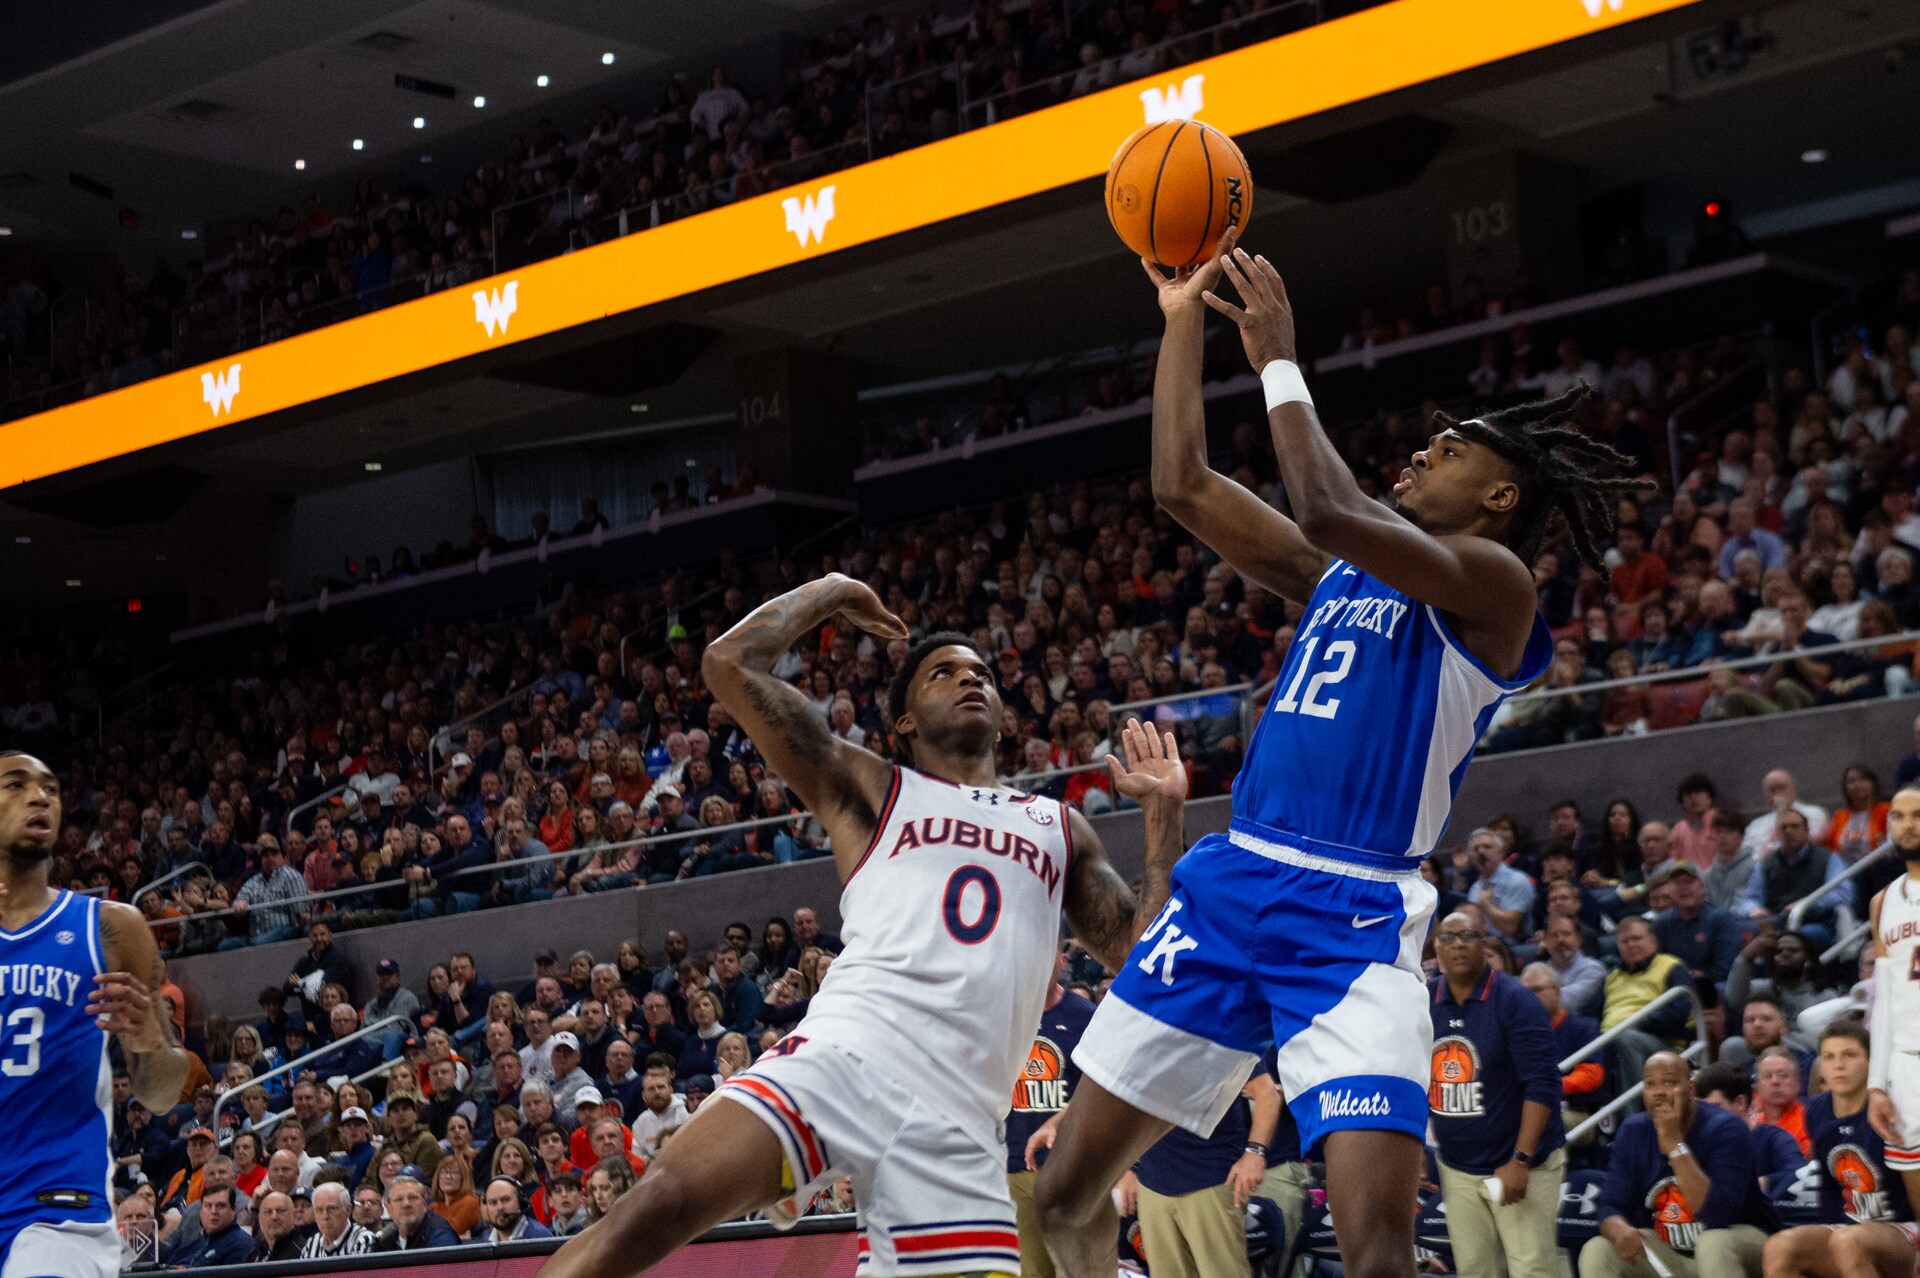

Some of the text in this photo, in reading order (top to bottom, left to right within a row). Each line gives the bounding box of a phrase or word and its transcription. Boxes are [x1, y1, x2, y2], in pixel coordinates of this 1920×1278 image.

[781, 185, 836, 248] W
[1227, 177, 1242, 228] NCA
[1453, 202, 1508, 244] 103
[472, 280, 519, 337] W
[201, 363, 241, 416] W
[741, 392, 780, 428] 104
[1274, 637, 1356, 719] 12
[888, 817, 1060, 903] AUBURN
[942, 864, 1001, 945] 0
[0, 1007, 46, 1077] 3
[1319, 1091, 1391, 1121] Wildcats
